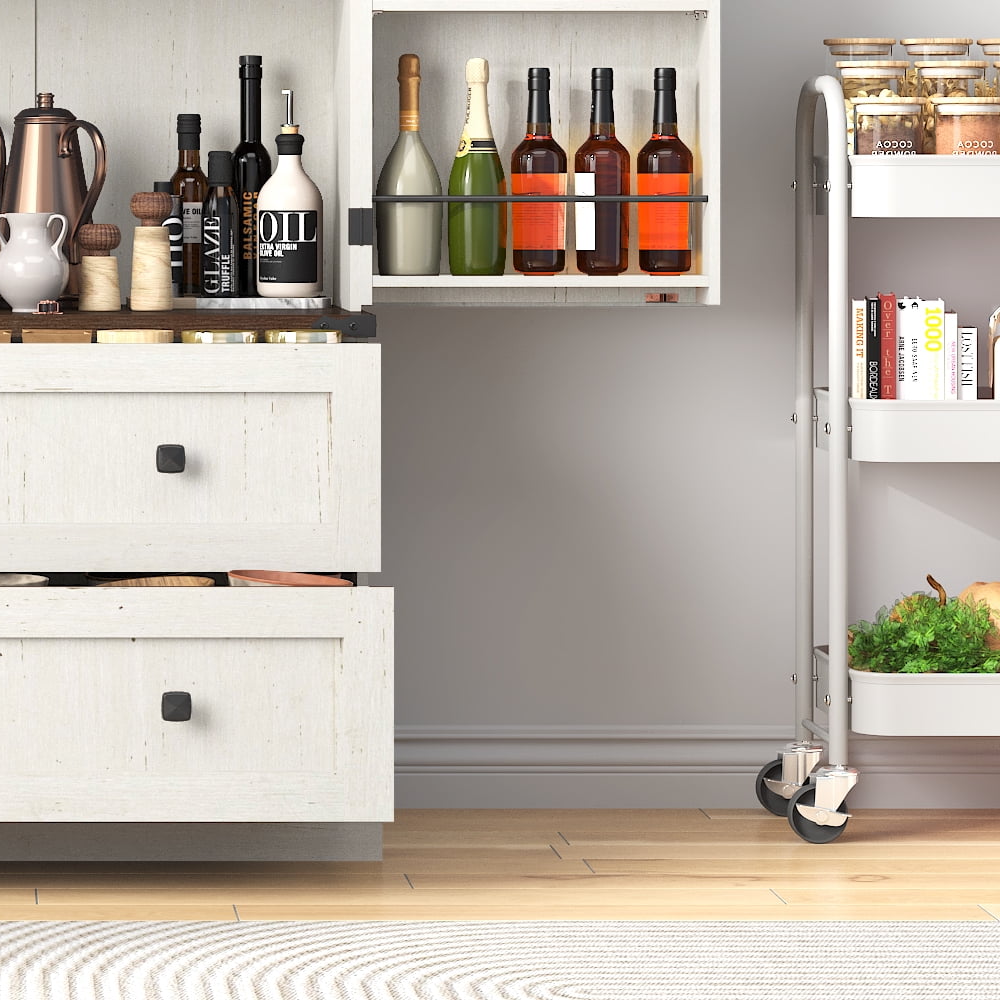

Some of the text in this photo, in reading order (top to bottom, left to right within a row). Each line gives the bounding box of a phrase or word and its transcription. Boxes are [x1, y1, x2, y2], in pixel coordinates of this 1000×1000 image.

[243, 191, 254, 260] BALSAMIC
[260, 211, 317, 243] OIL
[203, 216, 220, 294] GLAZE
[221, 254, 231, 293] TRUFFLE
[855, 308, 864, 346] MAKING
[883, 301, 893, 337] Over
[924, 307, 942, 352] 1000
[855, 348, 864, 358] IT
[961, 332, 973, 386] LOST FISH
